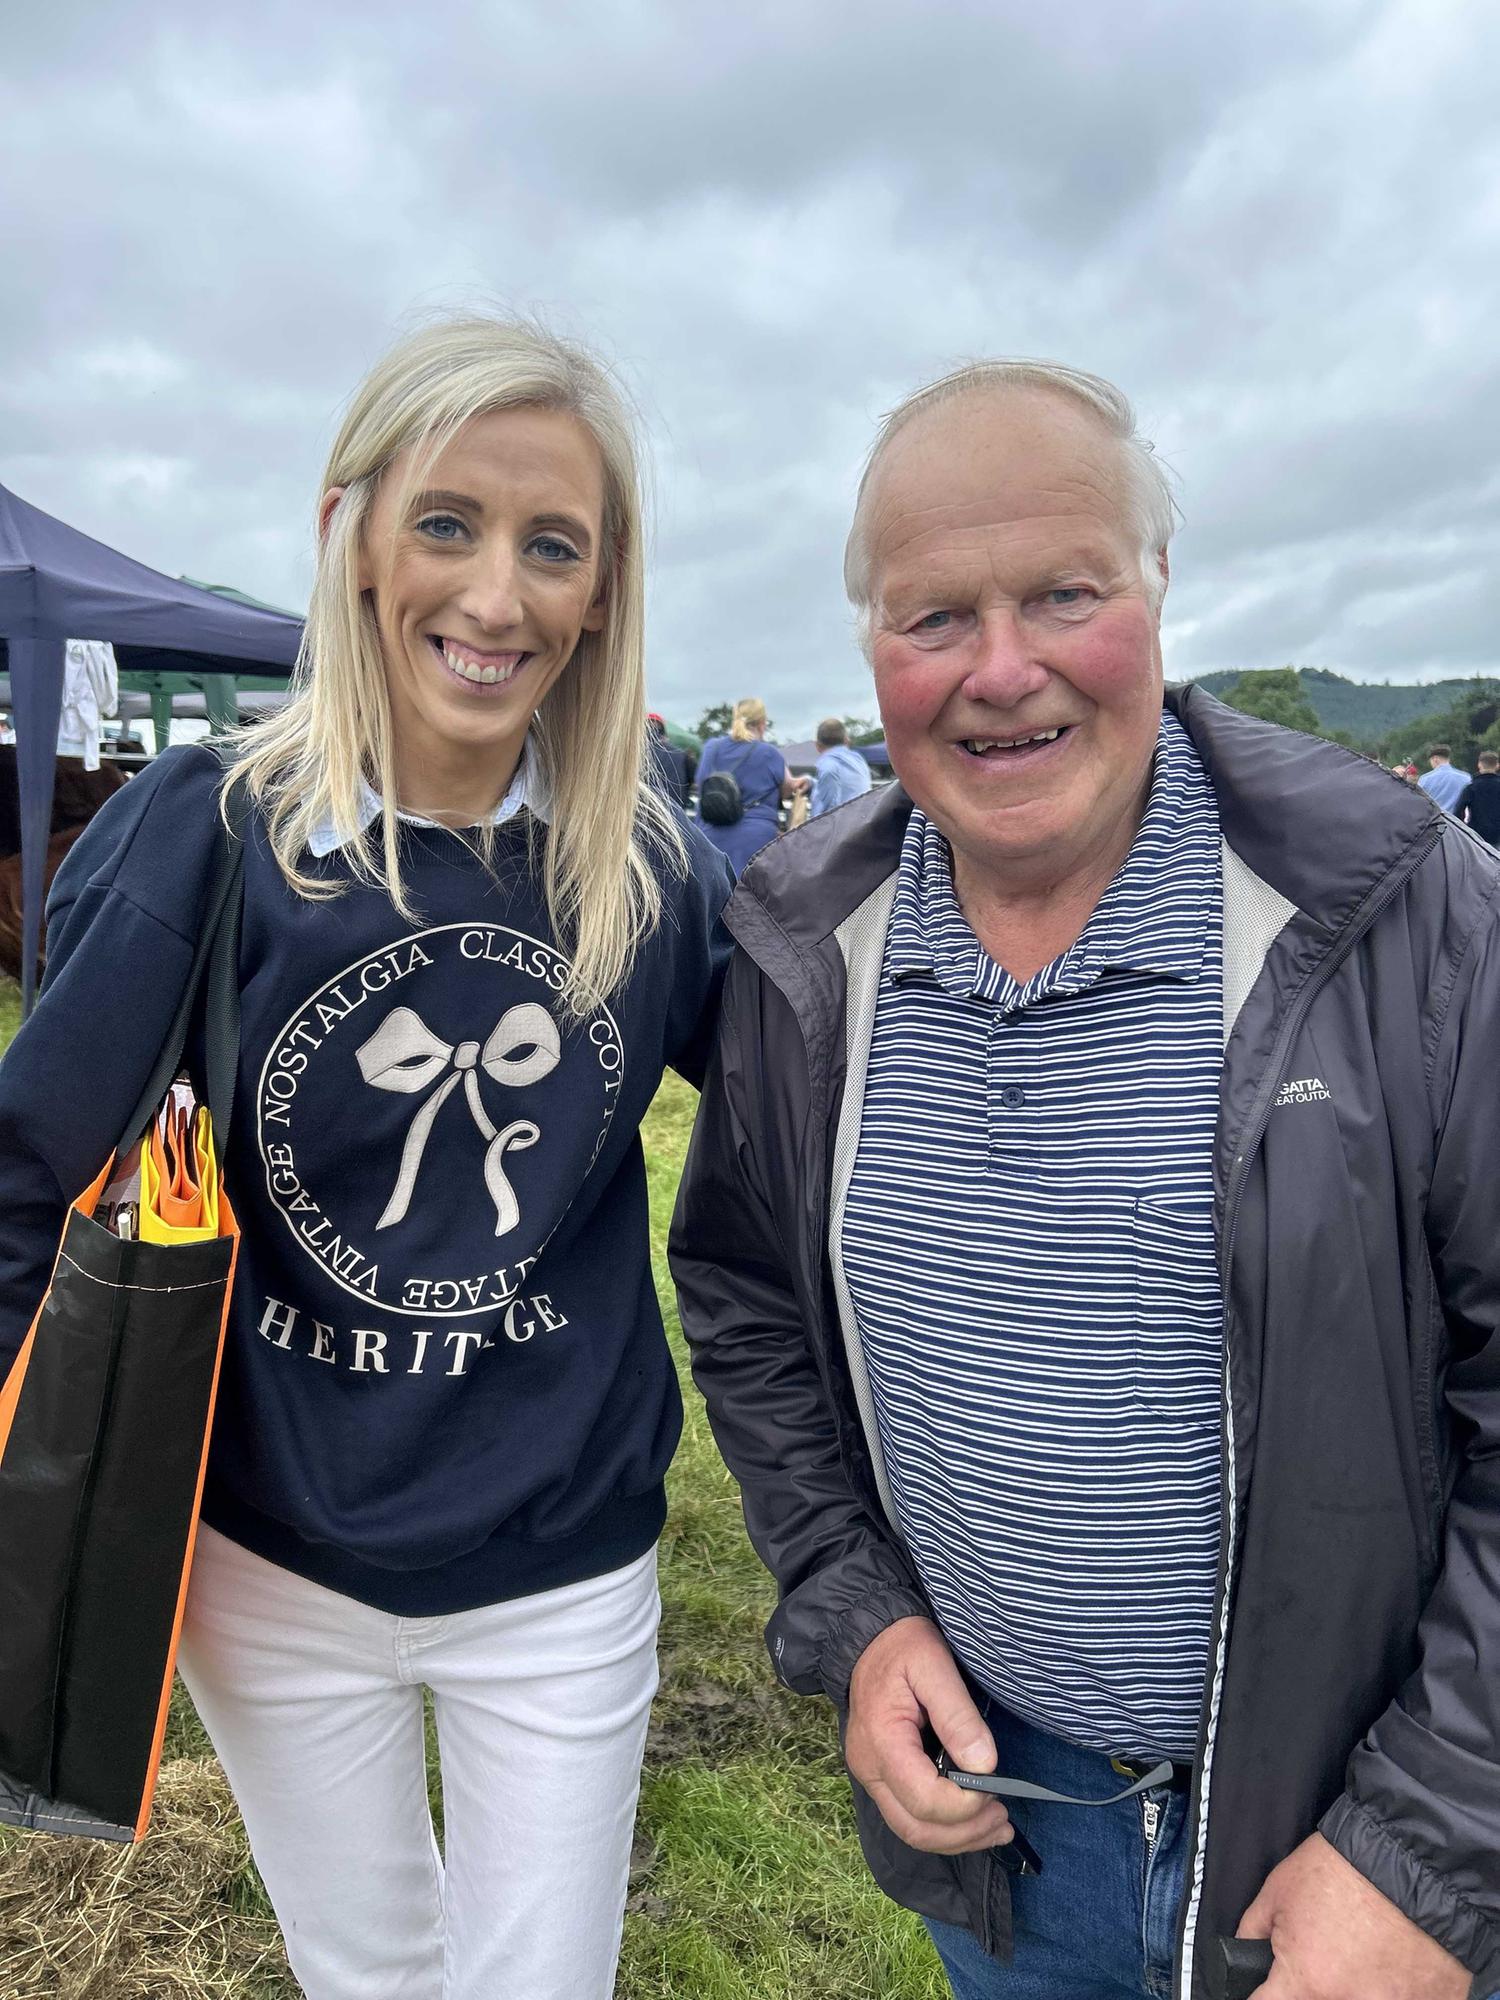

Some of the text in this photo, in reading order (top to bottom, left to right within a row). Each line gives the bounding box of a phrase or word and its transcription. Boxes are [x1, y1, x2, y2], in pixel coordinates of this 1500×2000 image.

[264, 943, 434, 1128] NOSTALGIA
[1275, 1094, 1295, 1106] EAT
[1280, 1078, 1324, 1095] GATTA
[269, 1143, 380, 1297] VINTAGE
[257, 1294, 568, 1376] HERITGE
